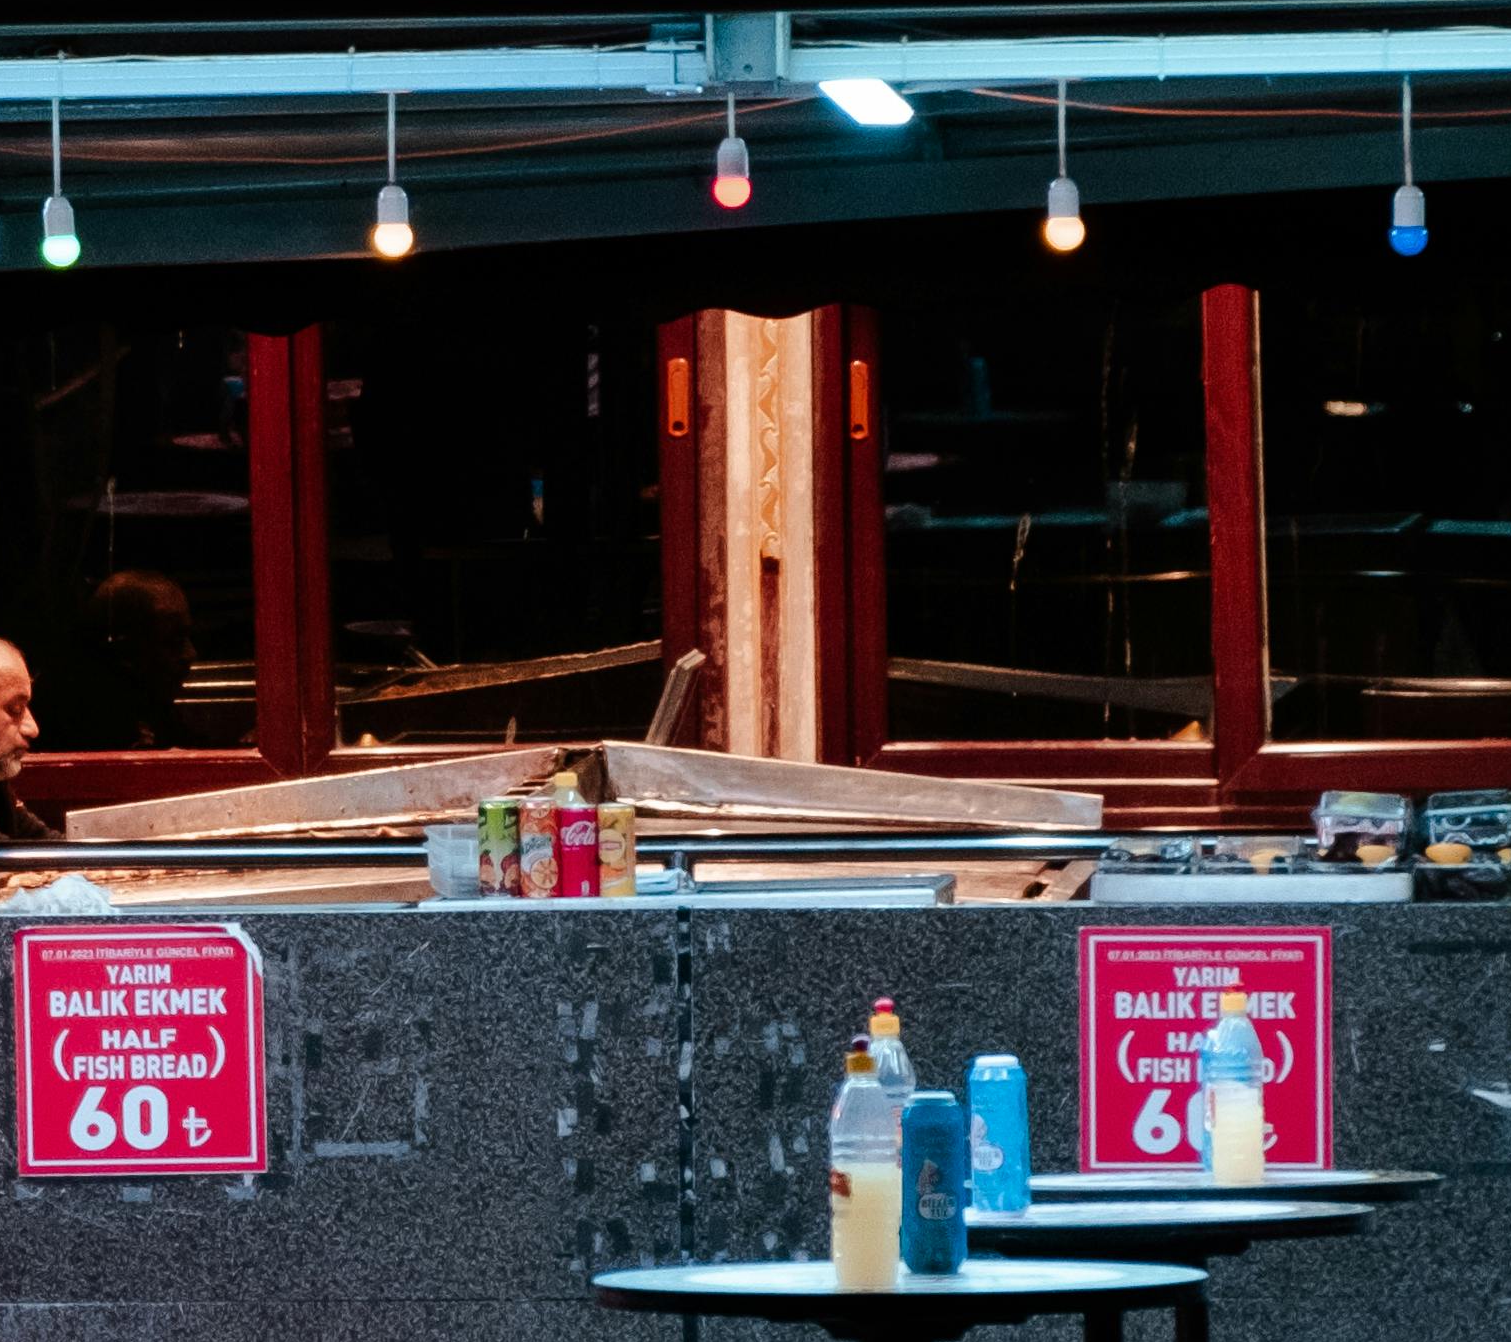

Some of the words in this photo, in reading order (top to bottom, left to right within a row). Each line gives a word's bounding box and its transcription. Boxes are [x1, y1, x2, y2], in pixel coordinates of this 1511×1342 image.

[106, 964, 172, 985] YARIM
[1173, 967, 1240, 987] YARIM
[49, 990, 129, 1018] BALIK
[135, 987, 228, 1016] EKMEK
[1114, 991, 1196, 1019] BALIK
[1201, 991, 1296, 1019] EMEK
[101, 1028, 177, 1050] HALF
[72, 1055, 125, 1080] FISH
[1137, 1058, 1190, 1083] FISH
